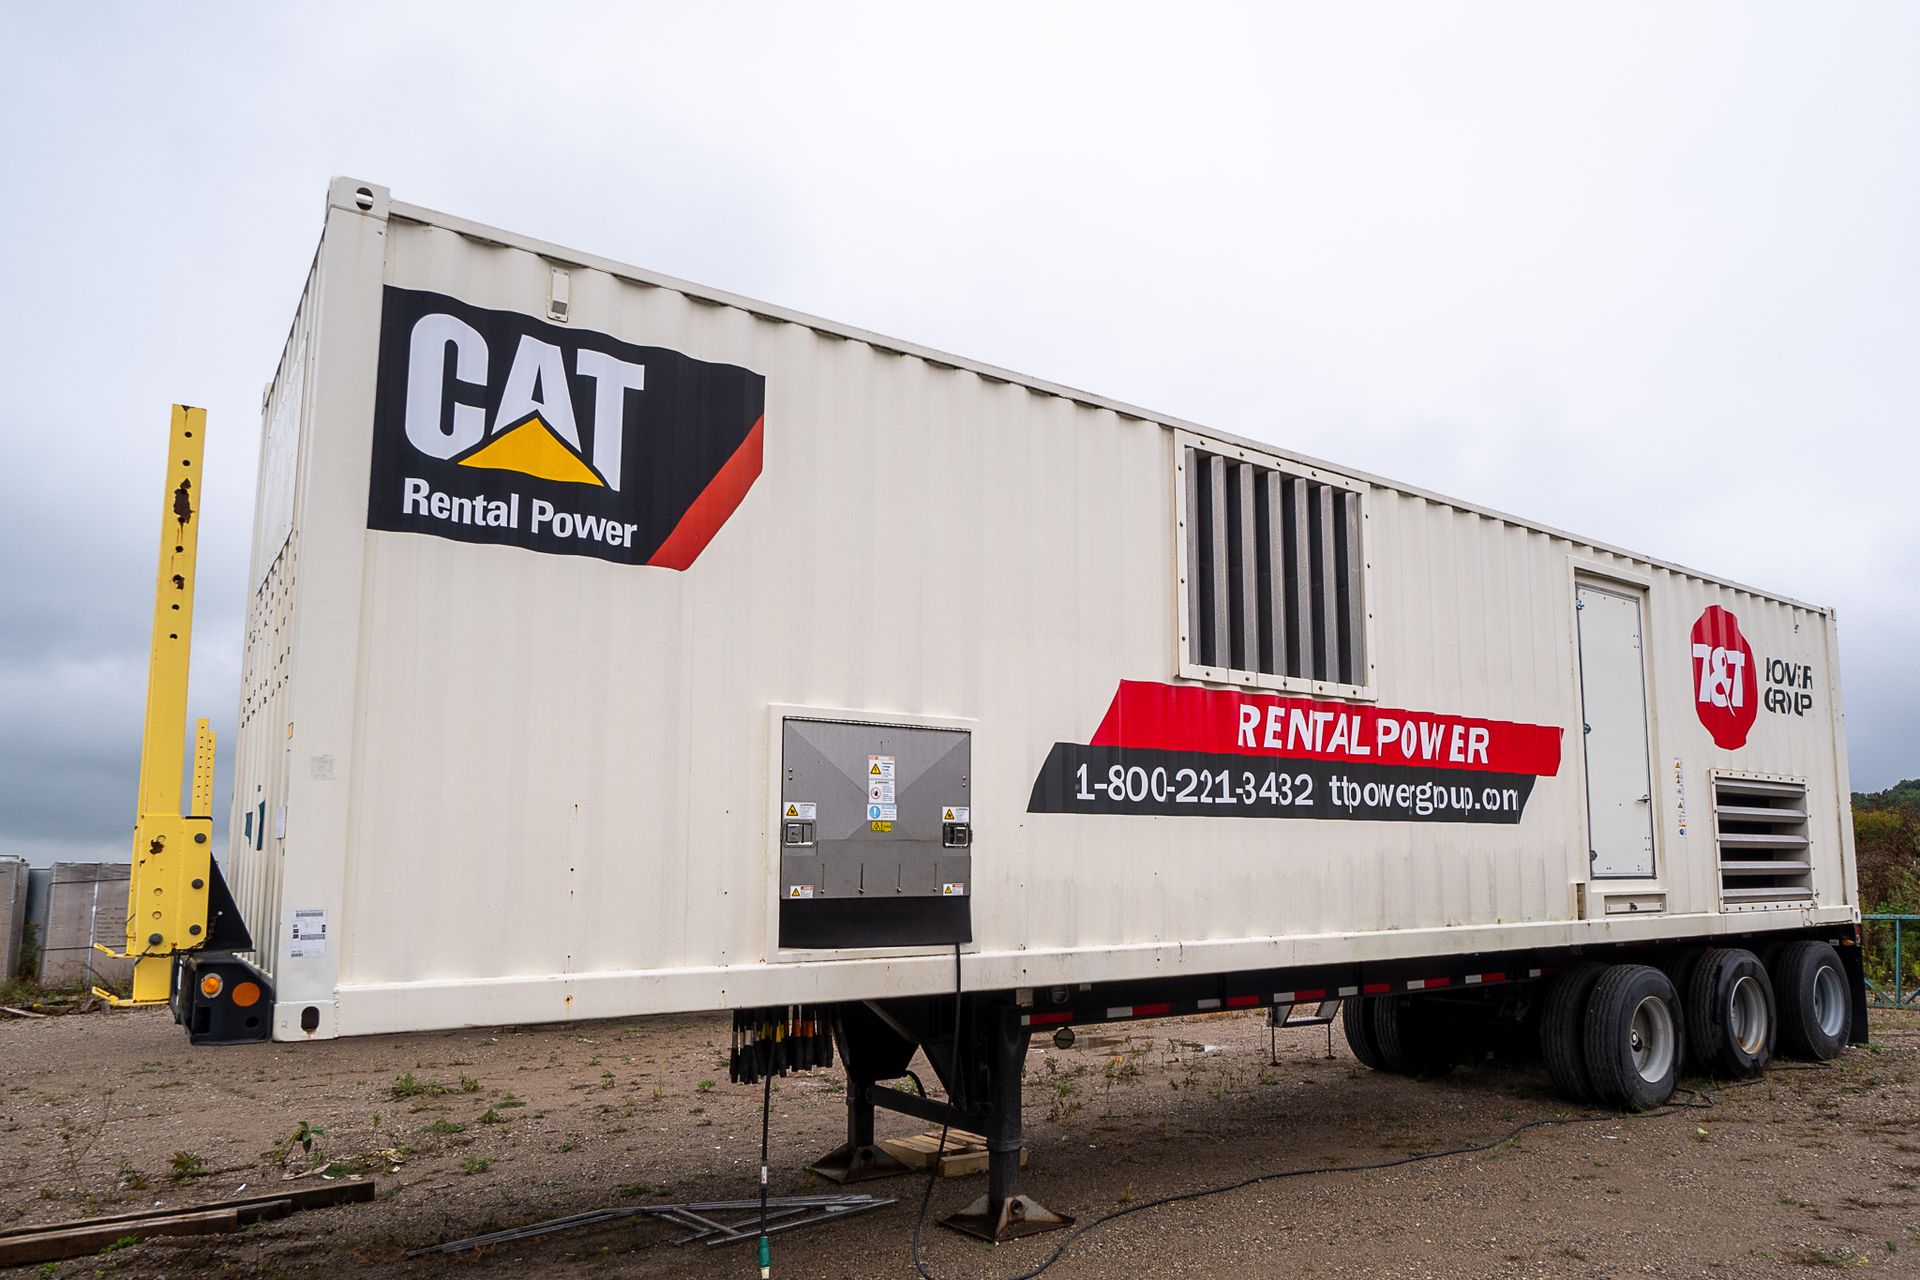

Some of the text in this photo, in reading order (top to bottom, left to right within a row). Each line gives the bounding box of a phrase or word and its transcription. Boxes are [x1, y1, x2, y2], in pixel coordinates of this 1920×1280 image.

[405, 313, 645, 492] CAT
[403, 477, 637, 548] Rental Power
[1237, 703, 1490, 764] RENTAL POWER
[1076, 763, 1314, 806] 1-800-221-3432
